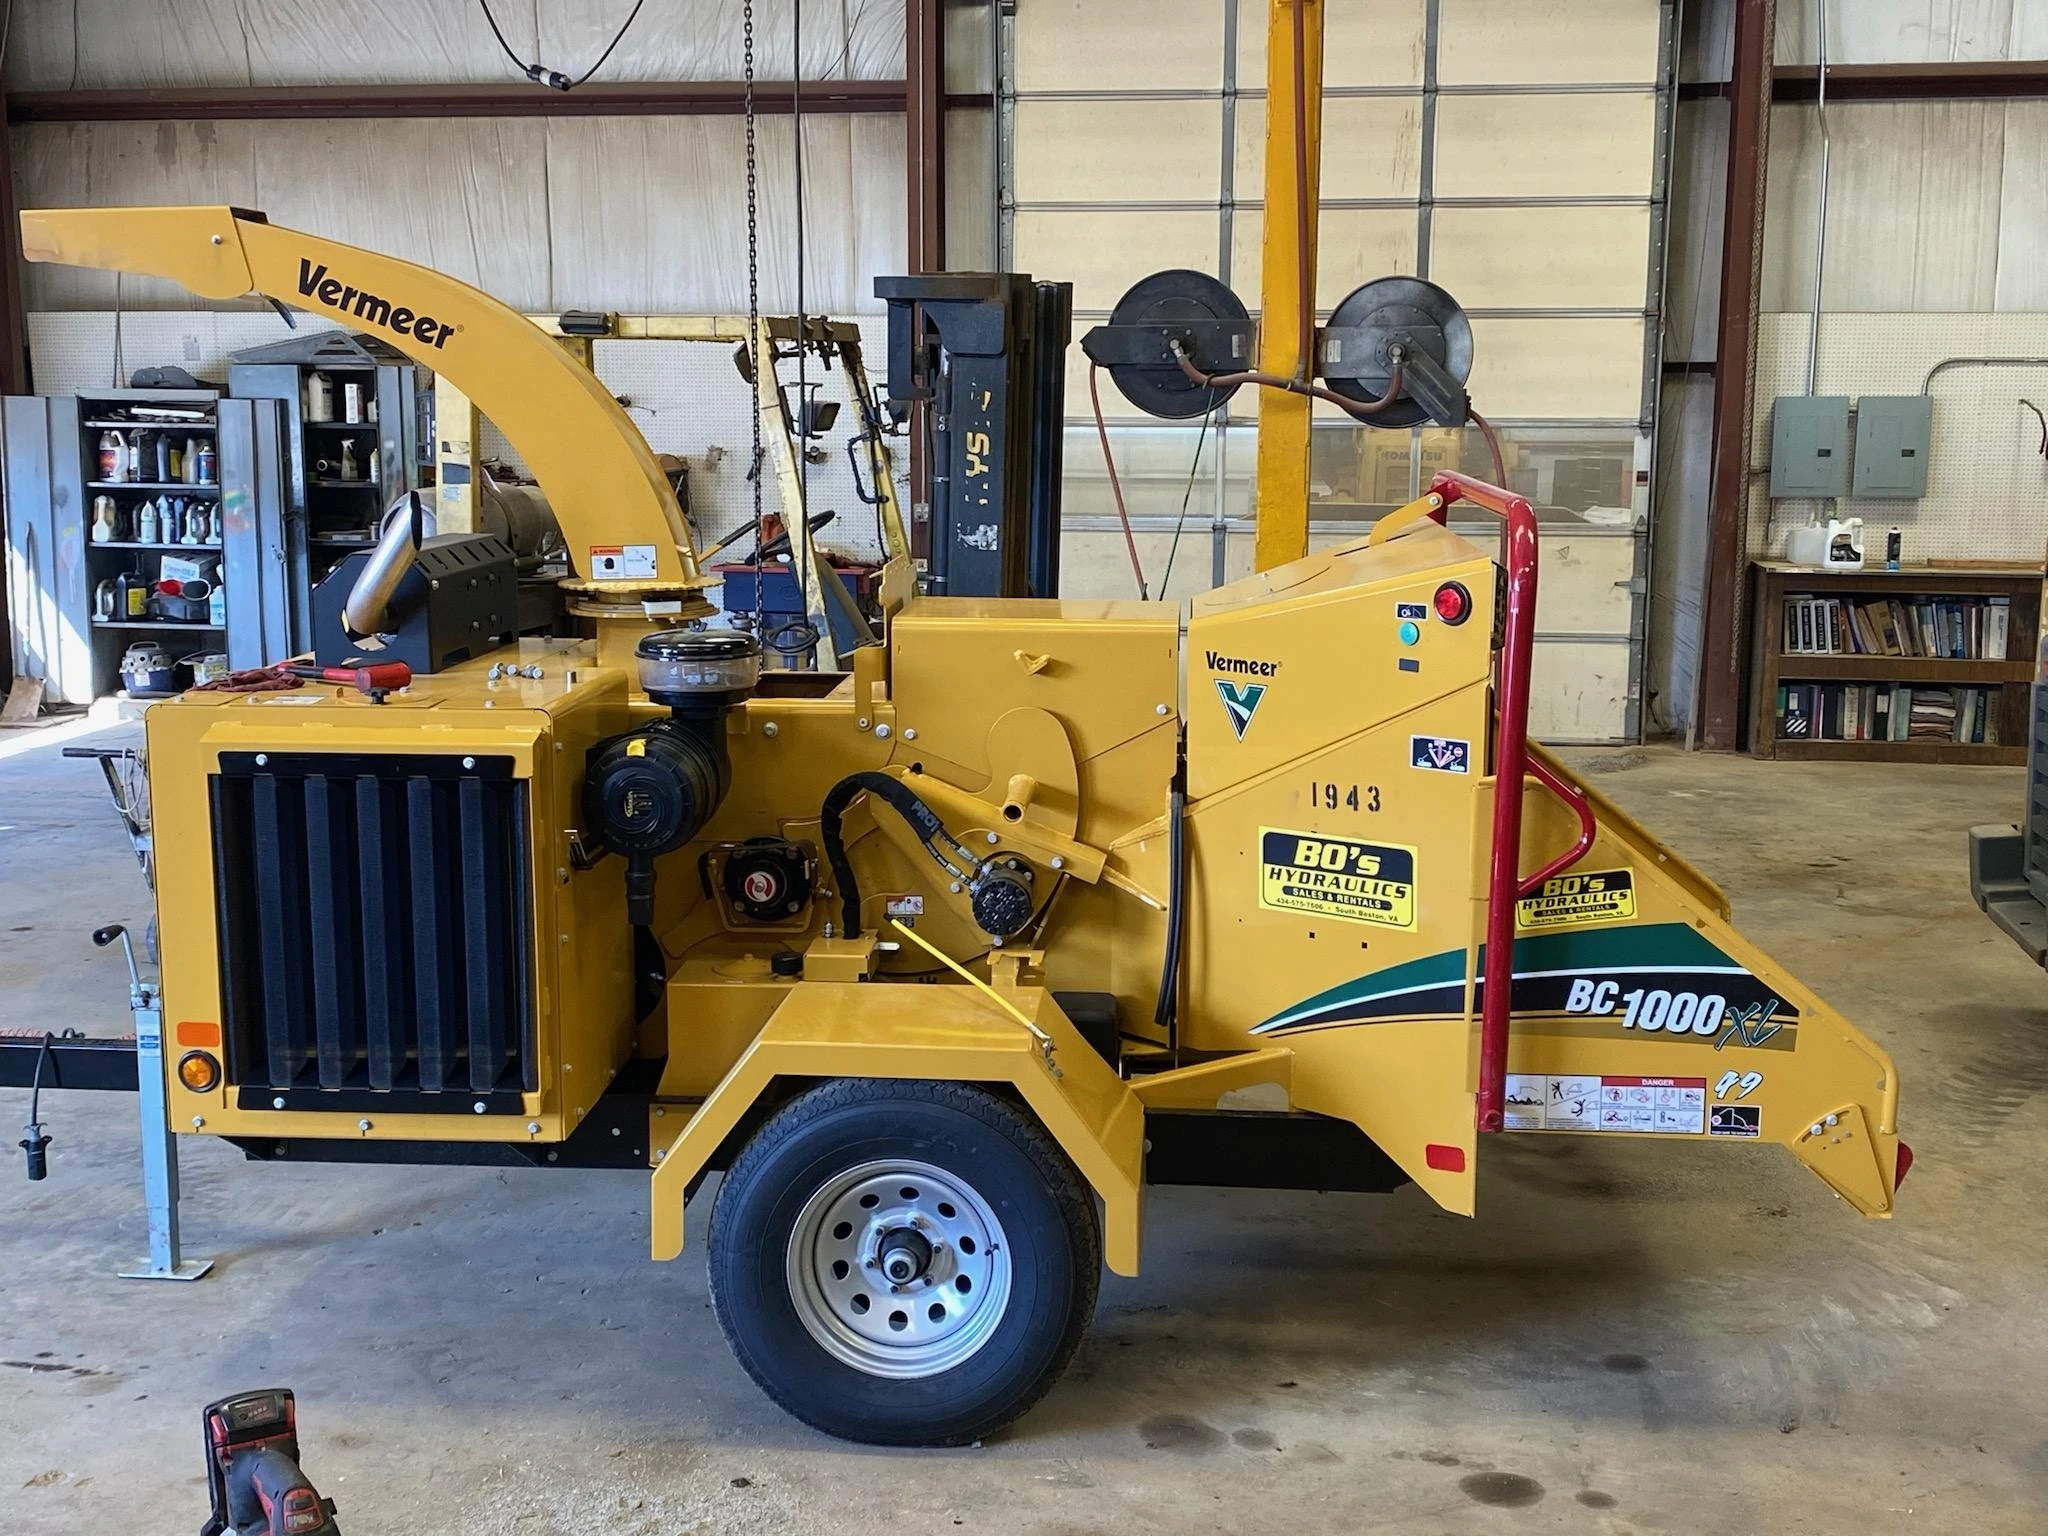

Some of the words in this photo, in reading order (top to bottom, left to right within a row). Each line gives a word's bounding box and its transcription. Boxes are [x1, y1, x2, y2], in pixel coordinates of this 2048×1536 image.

[298, 257, 455, 349] Vermeer
[1205, 650, 1278, 677] Vermeer
[1312, 782, 1381, 812] 1943
[1293, 839, 1382, 876] BO's
[1269, 867, 1407, 899] HYDRAULICS
[1543, 876, 1605, 897] BO's
[1292, 887, 1325, 900] SALES
[1327, 892, 1335, 901] &
[1337, 894, 1382, 909] RENTALS
[1522, 890, 1628, 910] HYDRAULICS
[1335, 906, 1357, 916] South
[1388, 915, 1399, 923] VA
[1622, 989, 1727, 1036] 1000
[1713, 998, 1784, 1051] XL
[1641, 1078, 1675, 1087] DANGER
